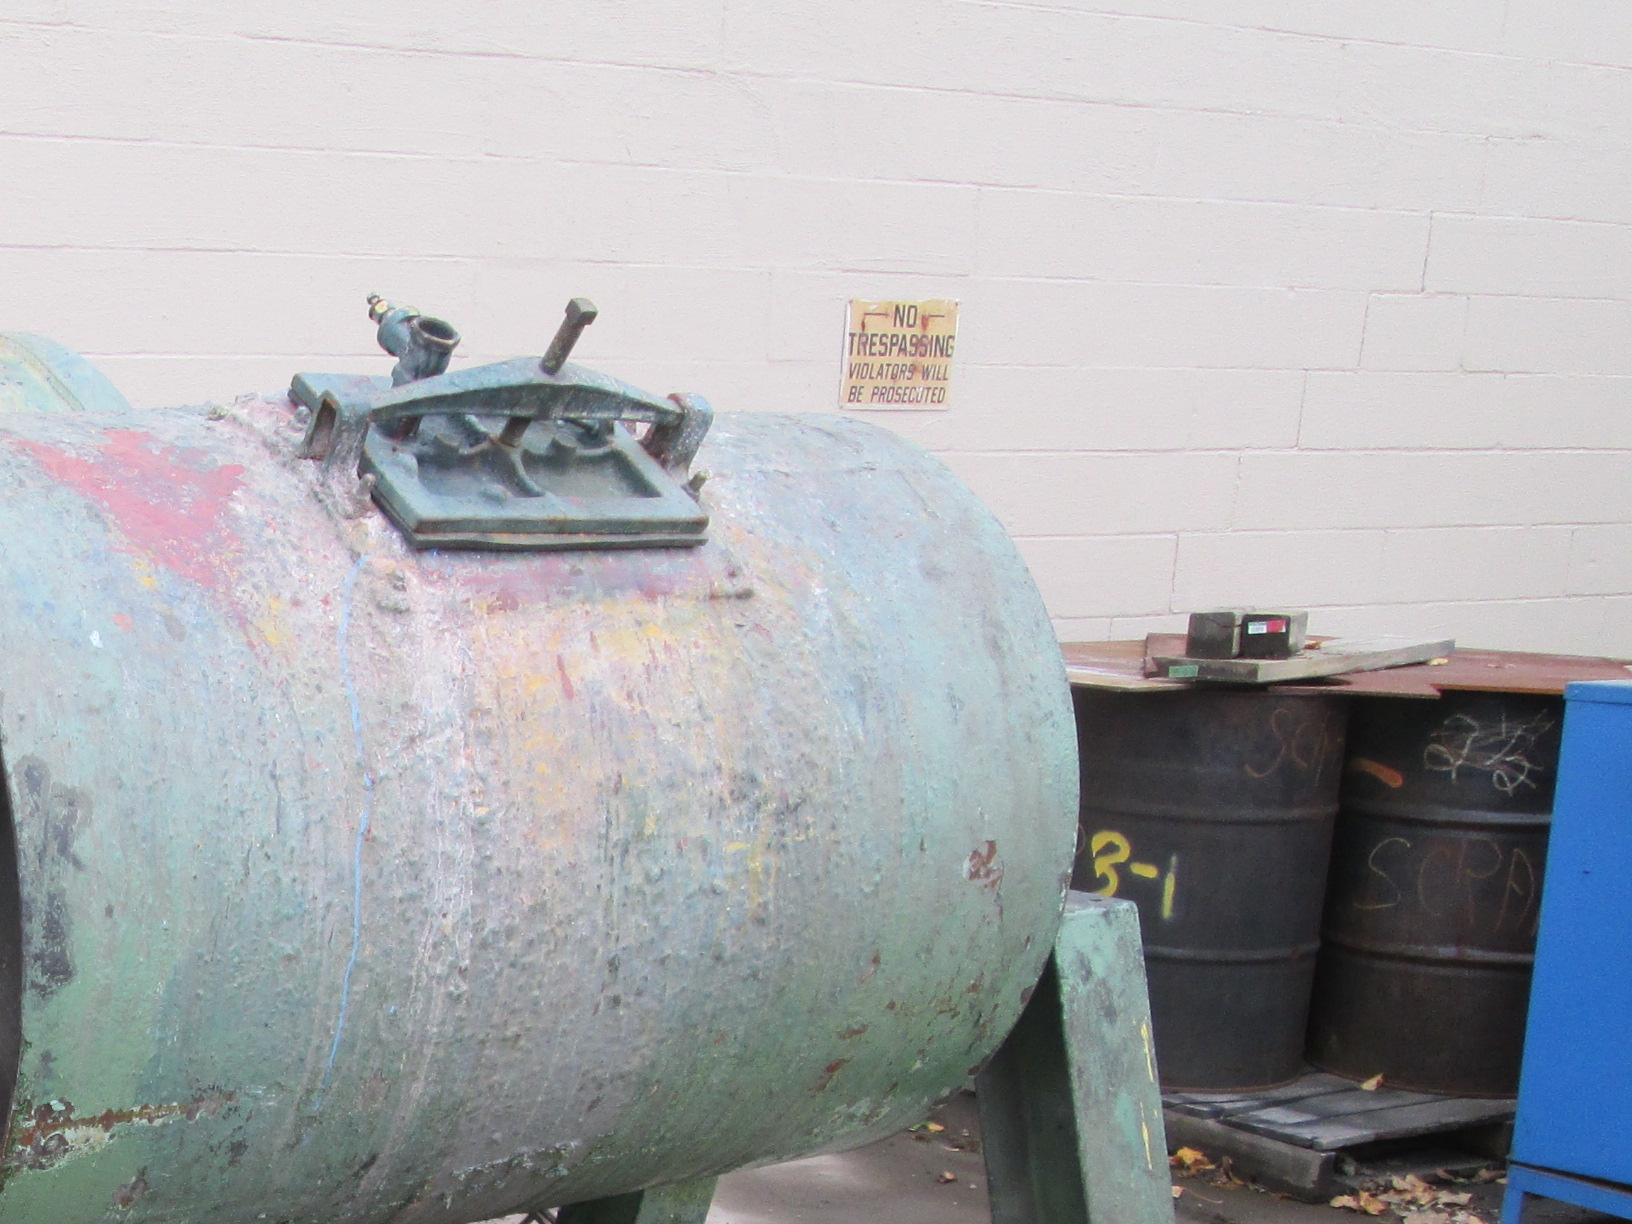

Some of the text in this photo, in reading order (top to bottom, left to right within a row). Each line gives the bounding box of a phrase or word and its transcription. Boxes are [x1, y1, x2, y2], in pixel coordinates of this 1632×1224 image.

[893, 304, 918, 328] NO
[848, 332, 956, 358] TRESPASSING
[848, 363, 949, 382] VIOLATORS WILL
[847, 385, 946, 404] BE PROSECUTED
